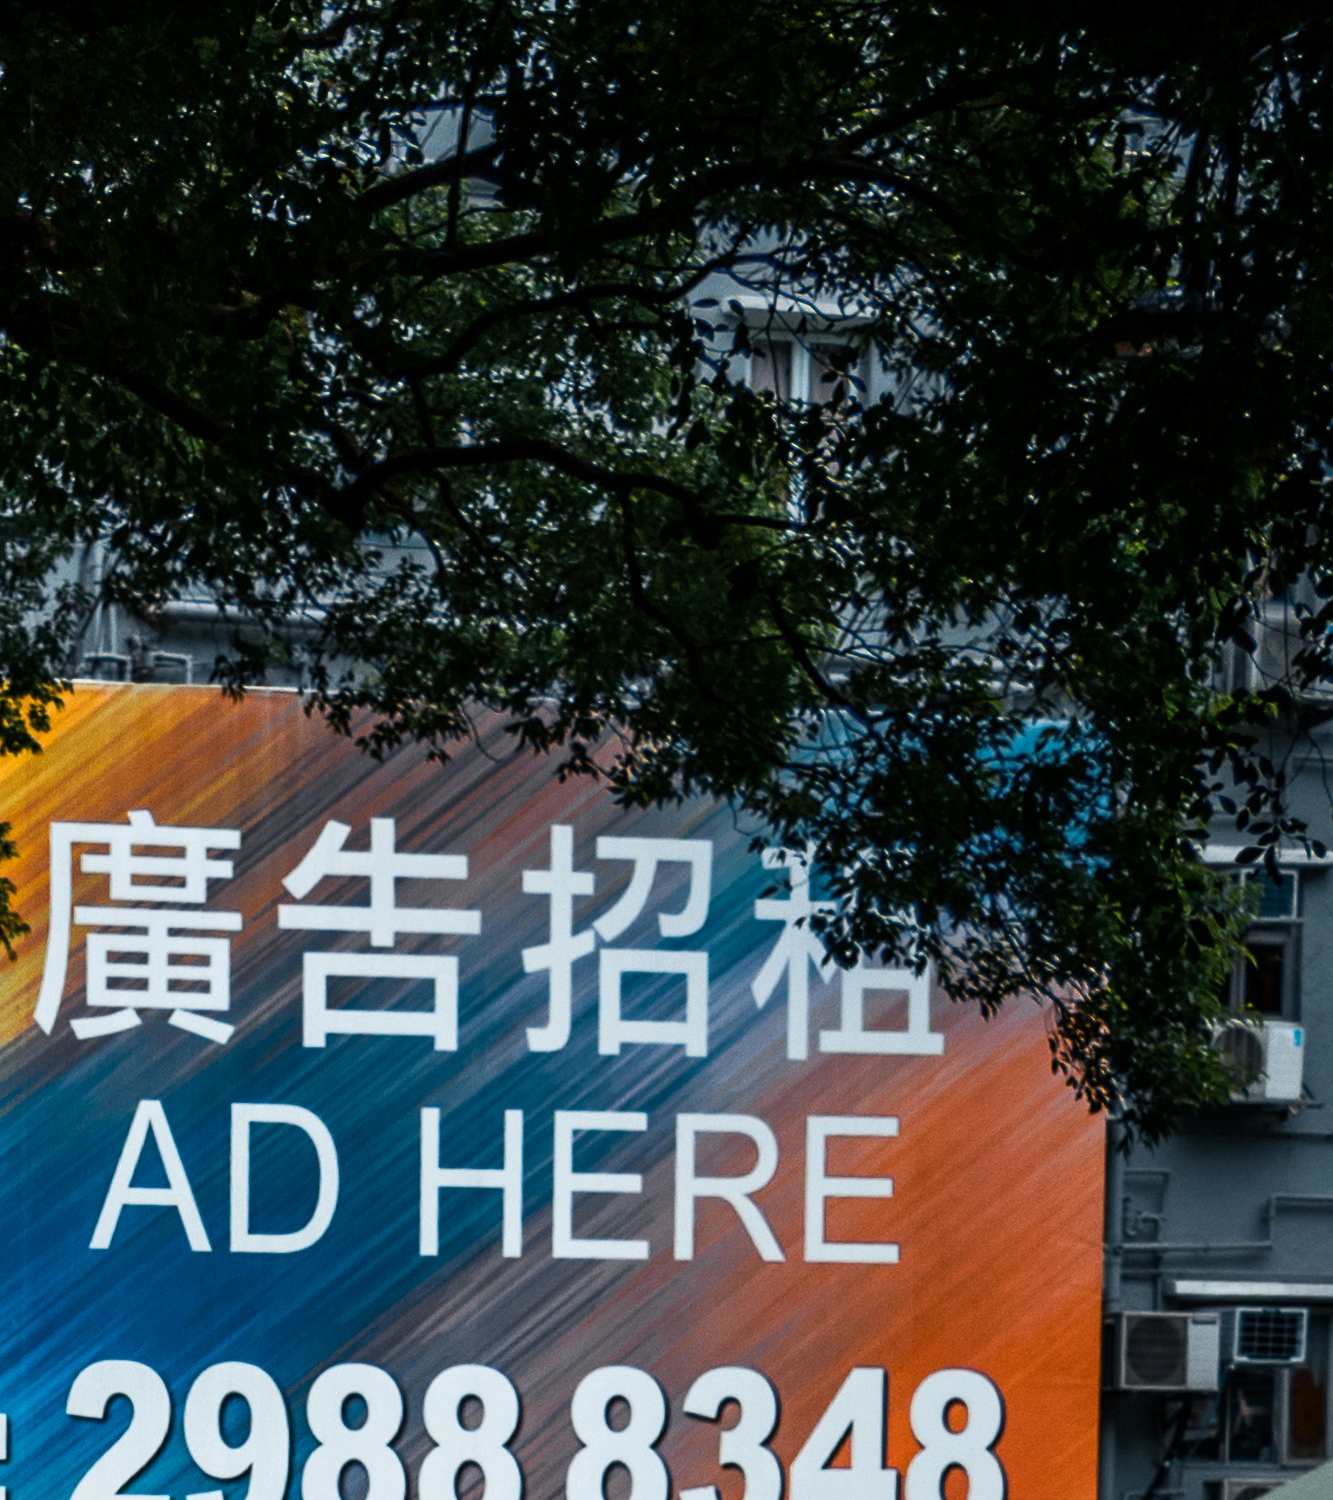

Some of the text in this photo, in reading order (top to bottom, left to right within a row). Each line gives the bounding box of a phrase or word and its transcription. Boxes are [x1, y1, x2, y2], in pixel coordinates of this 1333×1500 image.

[32, 808, 945, 1063] 廣告招租
[90, 1099, 901, 1265] AD HERE
